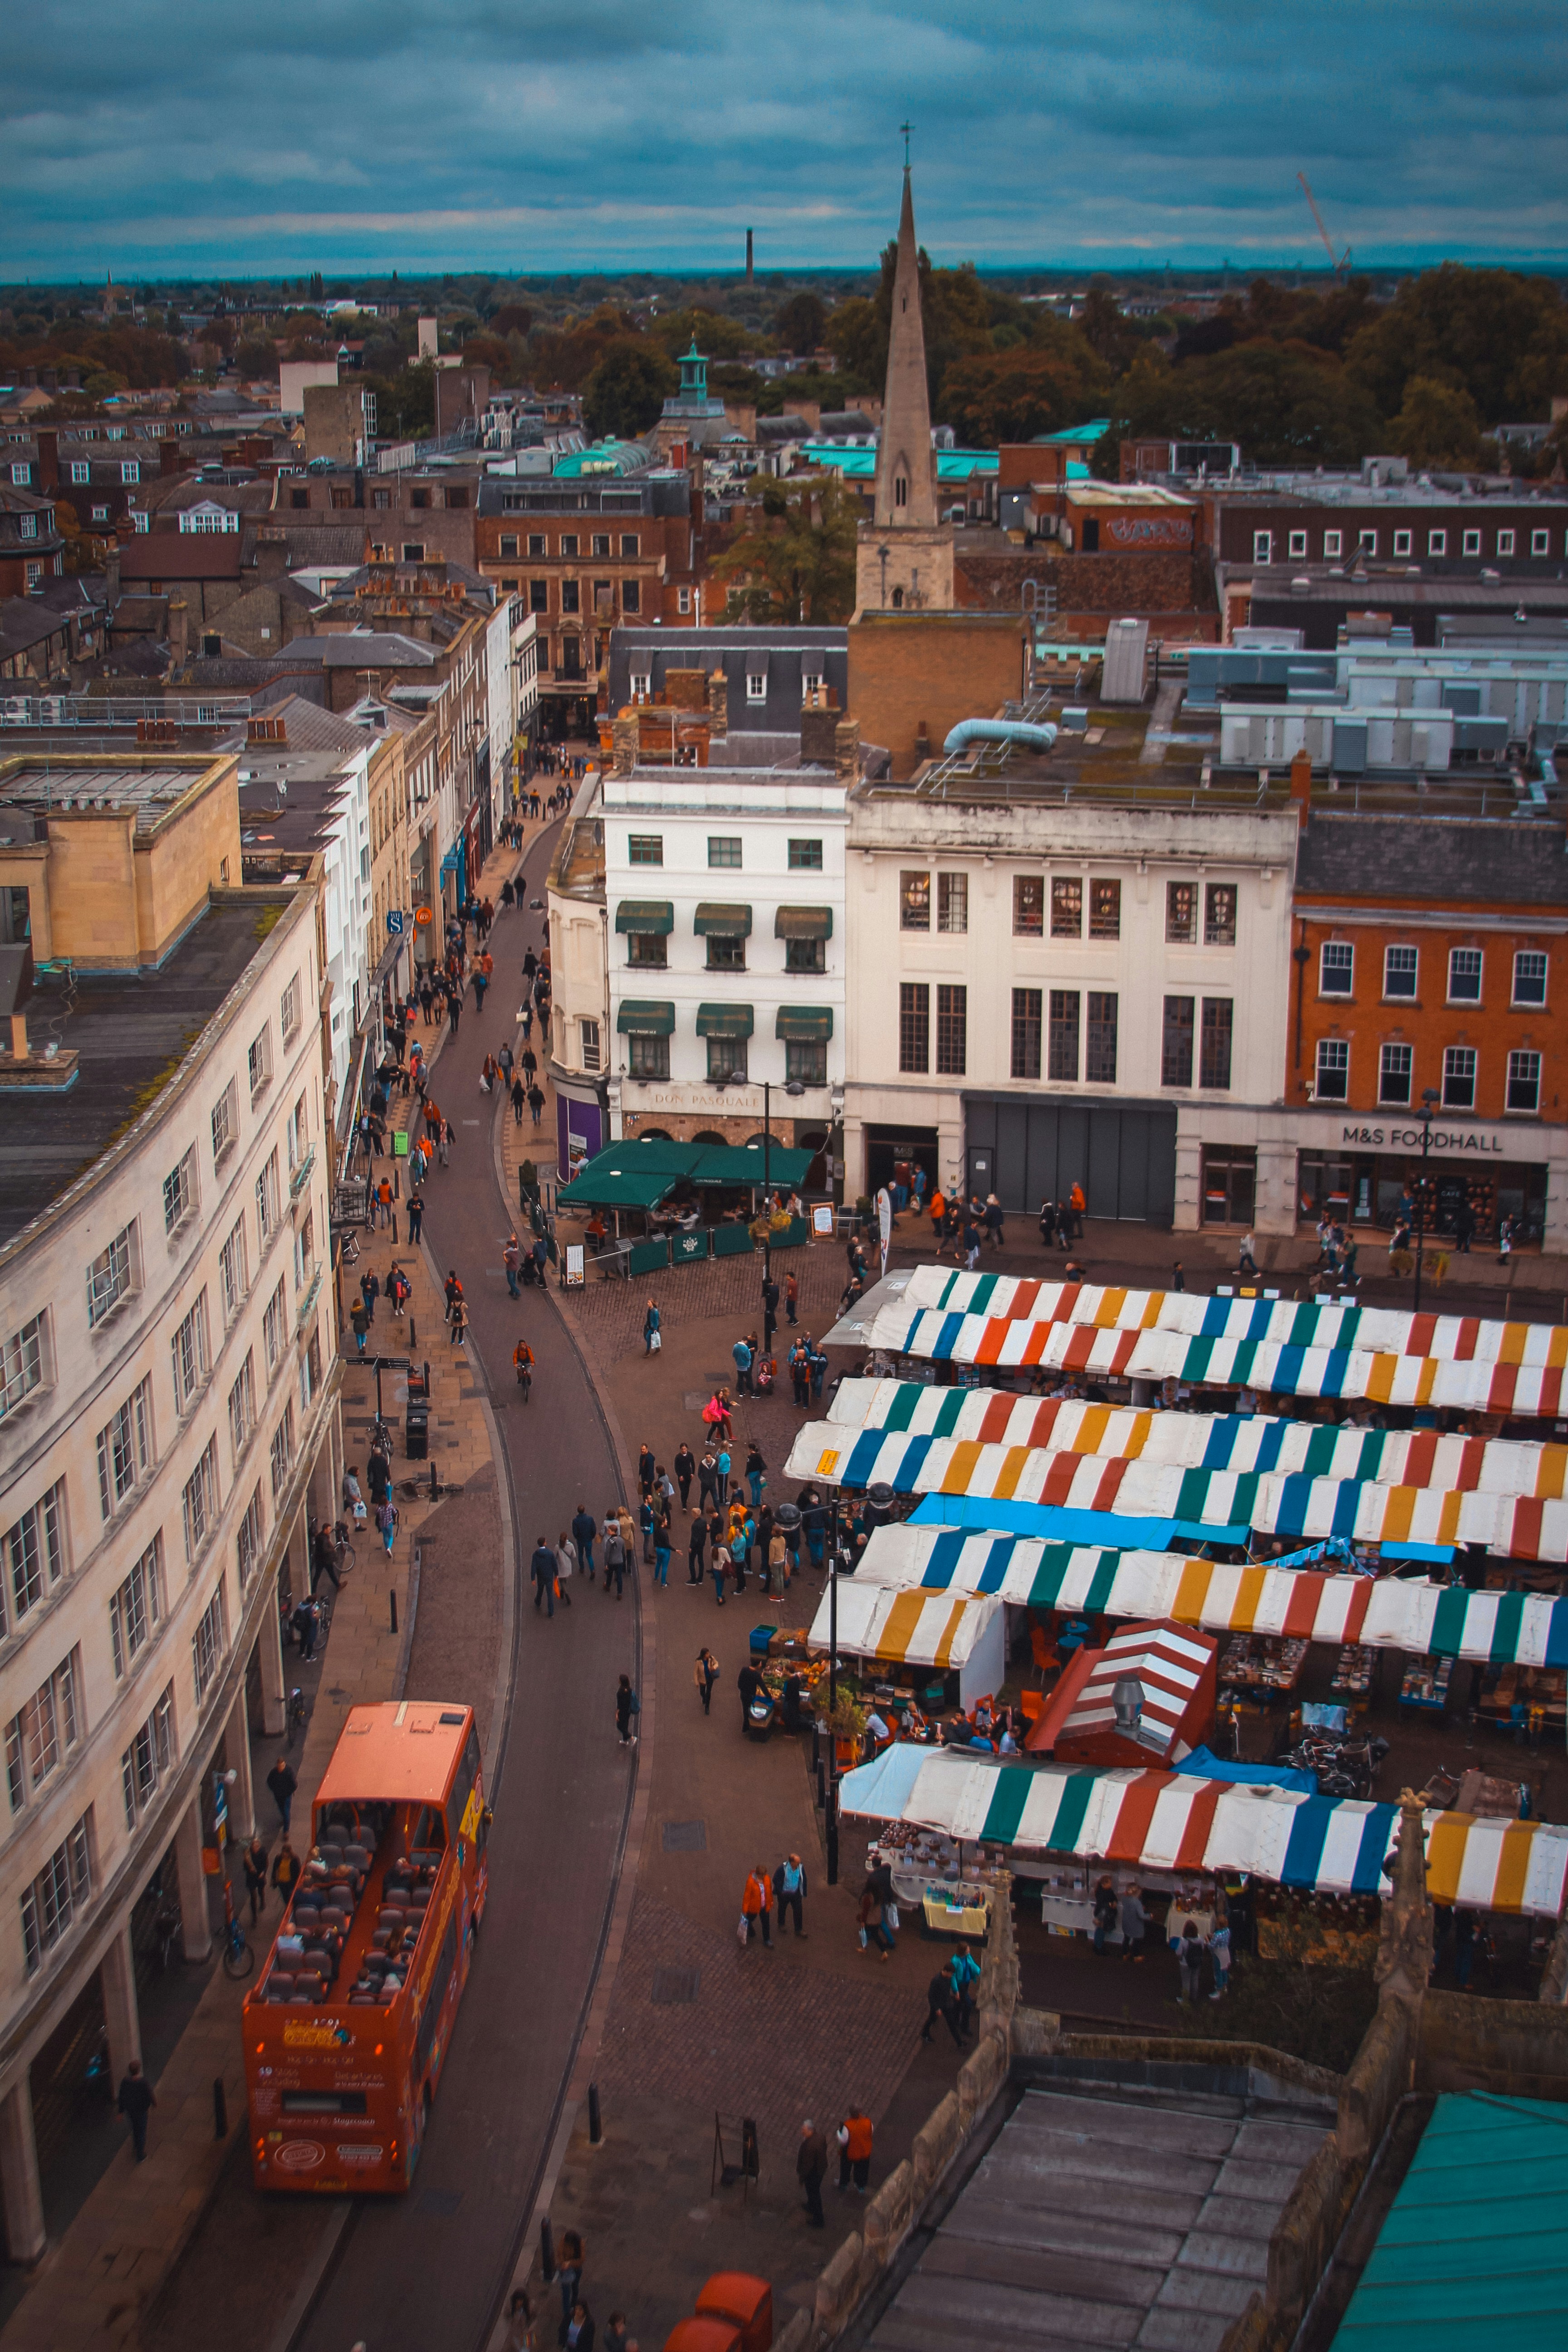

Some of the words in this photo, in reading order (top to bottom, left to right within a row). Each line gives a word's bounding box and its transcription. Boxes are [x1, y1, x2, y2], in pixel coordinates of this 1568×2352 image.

[391, 917, 401, 932] S
[655, 1094, 683, 1104] DON
[692, 1096, 759, 1107] PASQUALE
[1343, 1127, 1384, 1144] M&S
[1391, 1130, 1503, 1152] FOODHALL
[333, 2117, 375, 2127] Stagecoach
